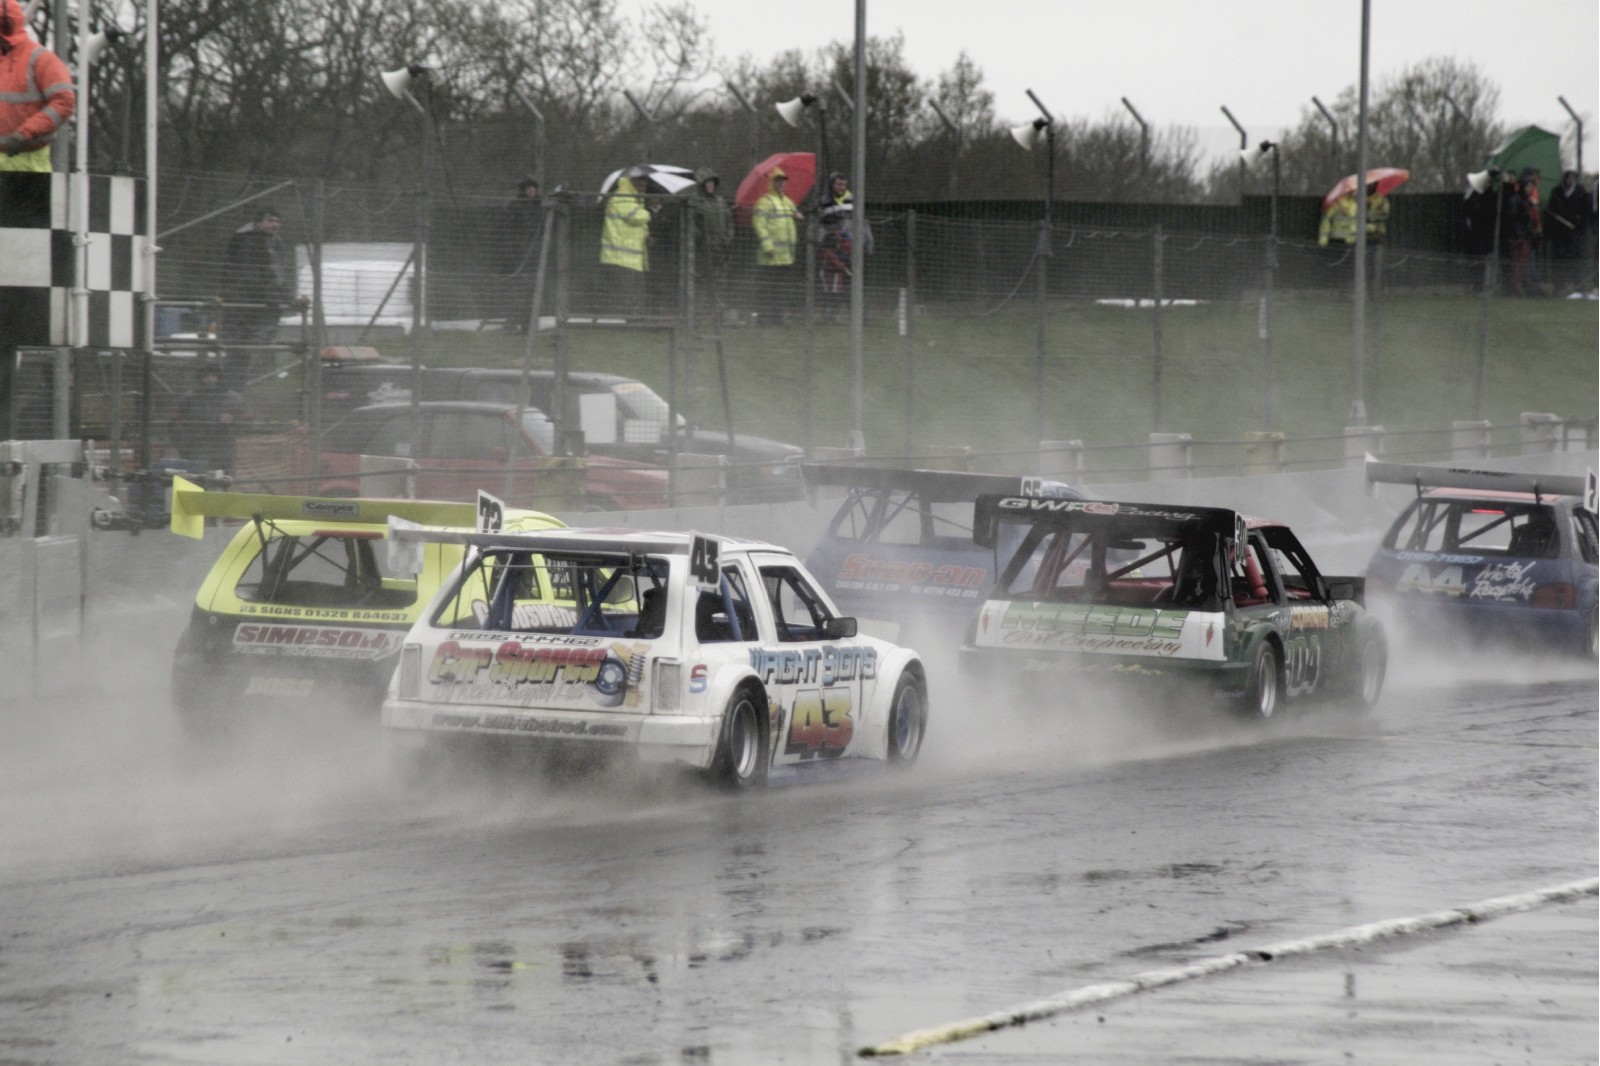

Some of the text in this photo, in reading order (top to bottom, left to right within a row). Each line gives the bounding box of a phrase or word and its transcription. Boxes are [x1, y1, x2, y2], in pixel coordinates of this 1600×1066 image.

[306, 502, 354, 513] Cooper
[691, 536, 719, 584] 43
[838, 553, 987, 589] Snap-on
[1395, 563, 1467, 596] A4
[261, 606, 301, 616] SIGNS
[305, 609, 349, 618] 01328
[236, 625, 387, 649] SIMPSON
[449, 632, 509, 641] 01895
[1061, 634, 1184, 655] Engineering
[428, 641, 607, 687] Car Spares
[783, 687, 854, 758] 43
